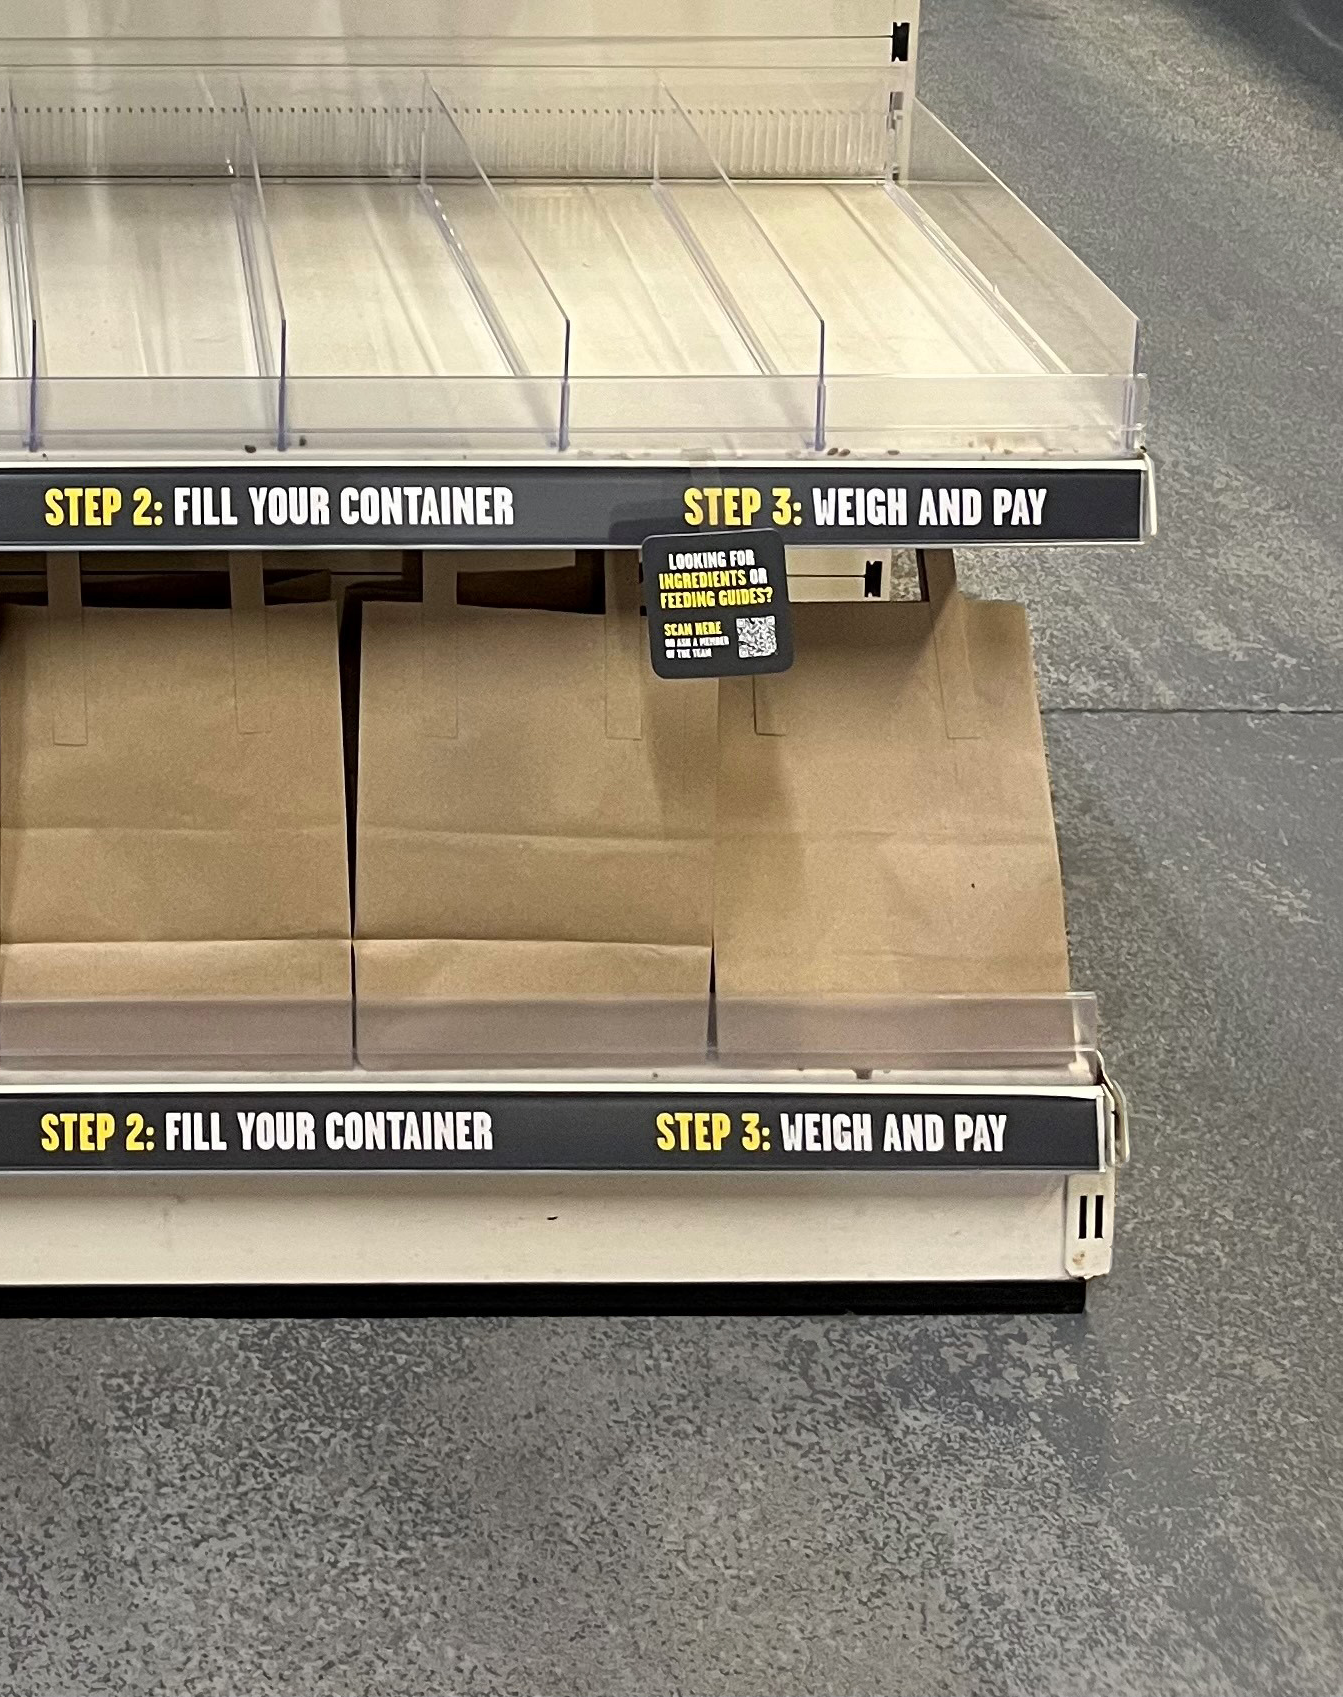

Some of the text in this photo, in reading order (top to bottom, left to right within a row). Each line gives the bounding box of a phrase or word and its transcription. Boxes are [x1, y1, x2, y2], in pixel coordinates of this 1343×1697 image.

[44, 486, 514, 527] STEP 2: FILL YOUR CONTAINER
[683, 487, 1047, 526] STEP 3: WEIGH AND PAY
[657, 567, 768, 590] INGREDIENTS OR
[667, 548, 756, 571] LOOKING FOR
[659, 586, 774, 609] FEEDING GUIDES?
[41, 1111, 493, 1152] STEP 2: FILL YOUR CONTAINER
[656, 1112, 1007, 1152] STEP 3: WEIGH AND PAY
